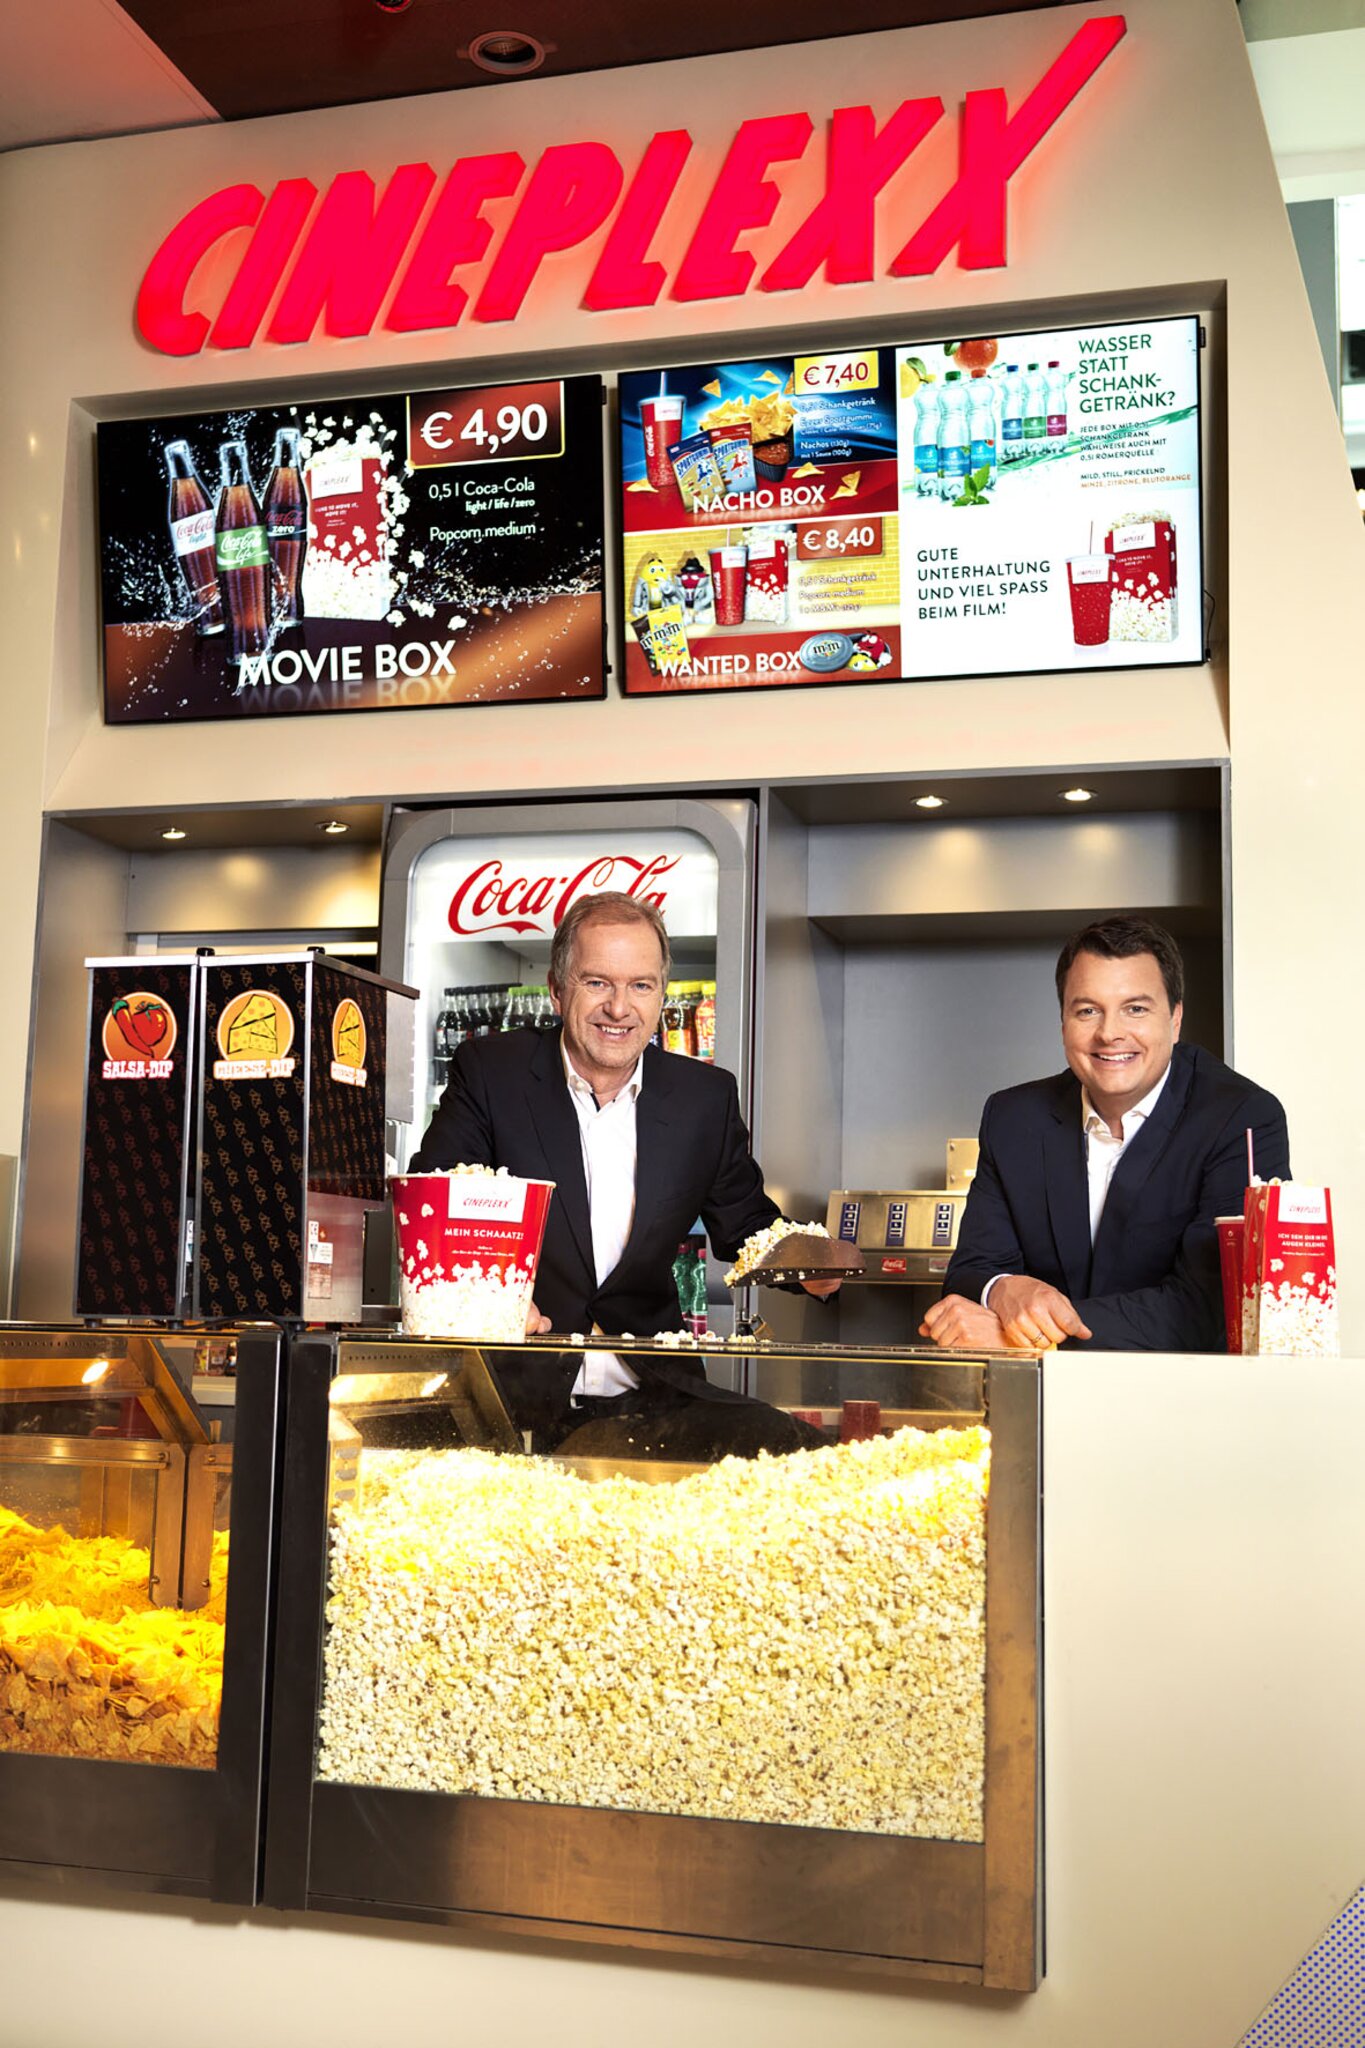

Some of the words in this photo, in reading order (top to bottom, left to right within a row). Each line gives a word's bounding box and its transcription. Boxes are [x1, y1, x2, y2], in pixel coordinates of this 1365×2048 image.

[135, 15, 1127, 356] CINEPLEXX
[1078, 334, 1152, 354] WASSER
[803, 366, 820, 385] €
[824, 362, 869, 388] 7,40
[1079, 356, 1128, 374] STATT
[1079, 373, 1162, 394] SCHANK-
[1080, 390, 1176, 413] GETRÄNK?
[420, 411, 454, 450] €
[460, 403, 548, 454] 4,90
[1128, 440, 1151, 448] AUCH
[1124, 467, 1166, 476] PRICKELND
[463, 476, 535, 496] Coca-Cola
[693, 489, 774, 514] NACHO
[780, 485, 826, 506] BOX
[272, 525, 295, 534] zero
[484, 521, 537, 538] medium
[803, 530, 821, 551] €
[825, 526, 875, 553] 8,40
[917, 547, 958, 562] GUTE
[918, 560, 1050, 581] UNTERHALTUNG
[918, 586, 954, 600] UND
[959, 584, 994, 597] VIEL
[1000, 580, 1048, 595] SPASS
[919, 606, 958, 619] BEIM
[963, 602, 1006, 617] FILM!
[239, 646, 364, 686] MOVIE
[375, 640, 457, 677] BOX
[660, 654, 750, 678] WANTED
[756, 651, 801, 673] BOX
[448, 855, 683, 935] Coca-Cla
[103, 1060, 174, 1080] SALSA-DIP
[214, 1058, 295, 1080] CHEESE-DIP
[463, 1197, 513, 1209] CINEPLEXX
[444, 1228, 471, 1237] MEIN
[473, 1229, 525, 1240] SCHAAATZ!
